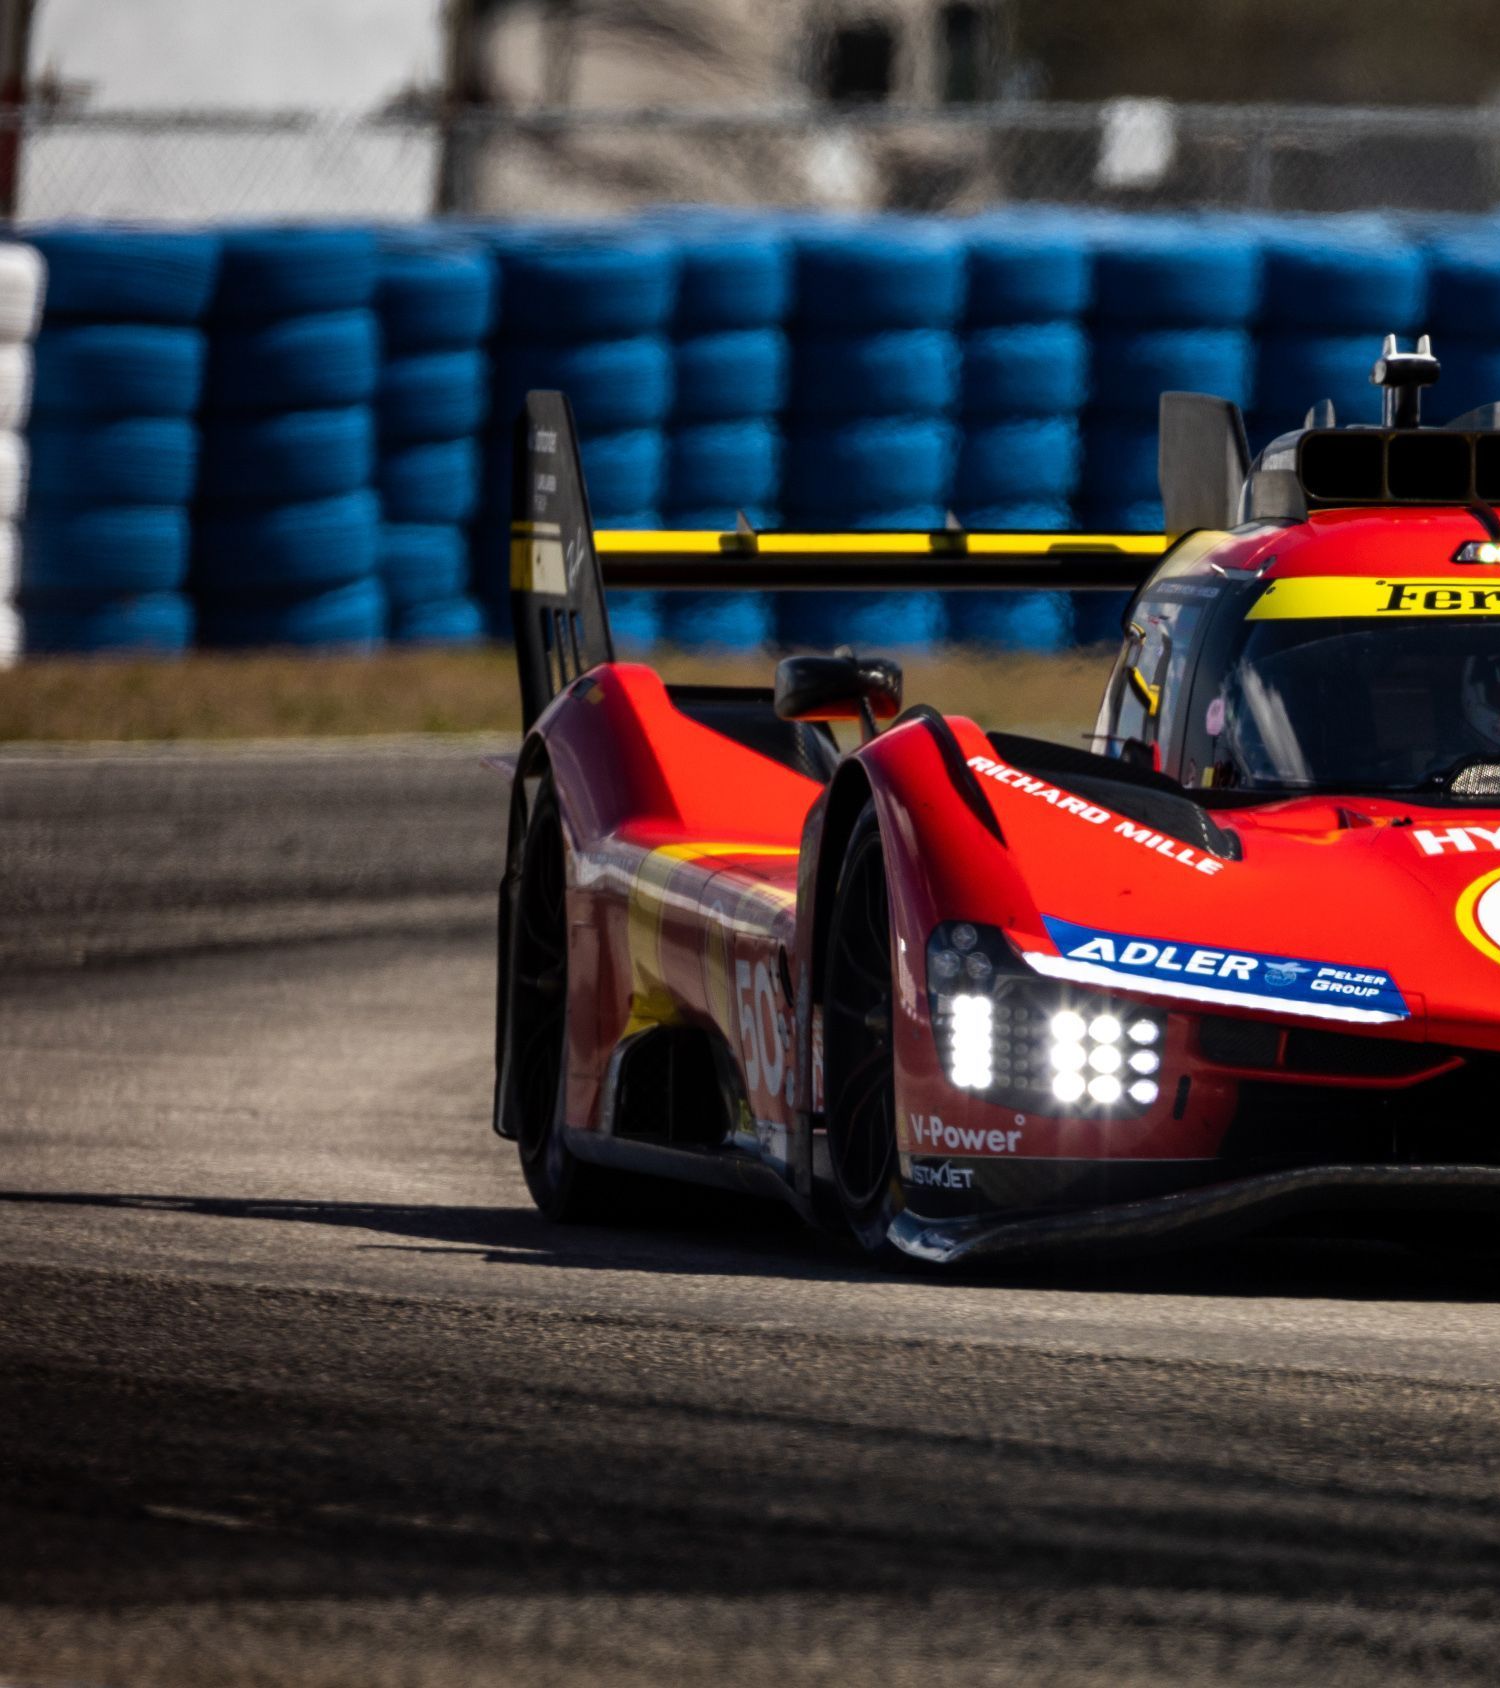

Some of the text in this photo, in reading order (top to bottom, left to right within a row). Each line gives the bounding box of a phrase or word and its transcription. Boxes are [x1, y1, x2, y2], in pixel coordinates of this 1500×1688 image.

[966, 756, 1224, 875] RICHARD MILLE
[1067, 937, 1259, 980] ADLER
[735, 959, 784, 1096] 50
[911, 1114, 1022, 1152] V-Power
